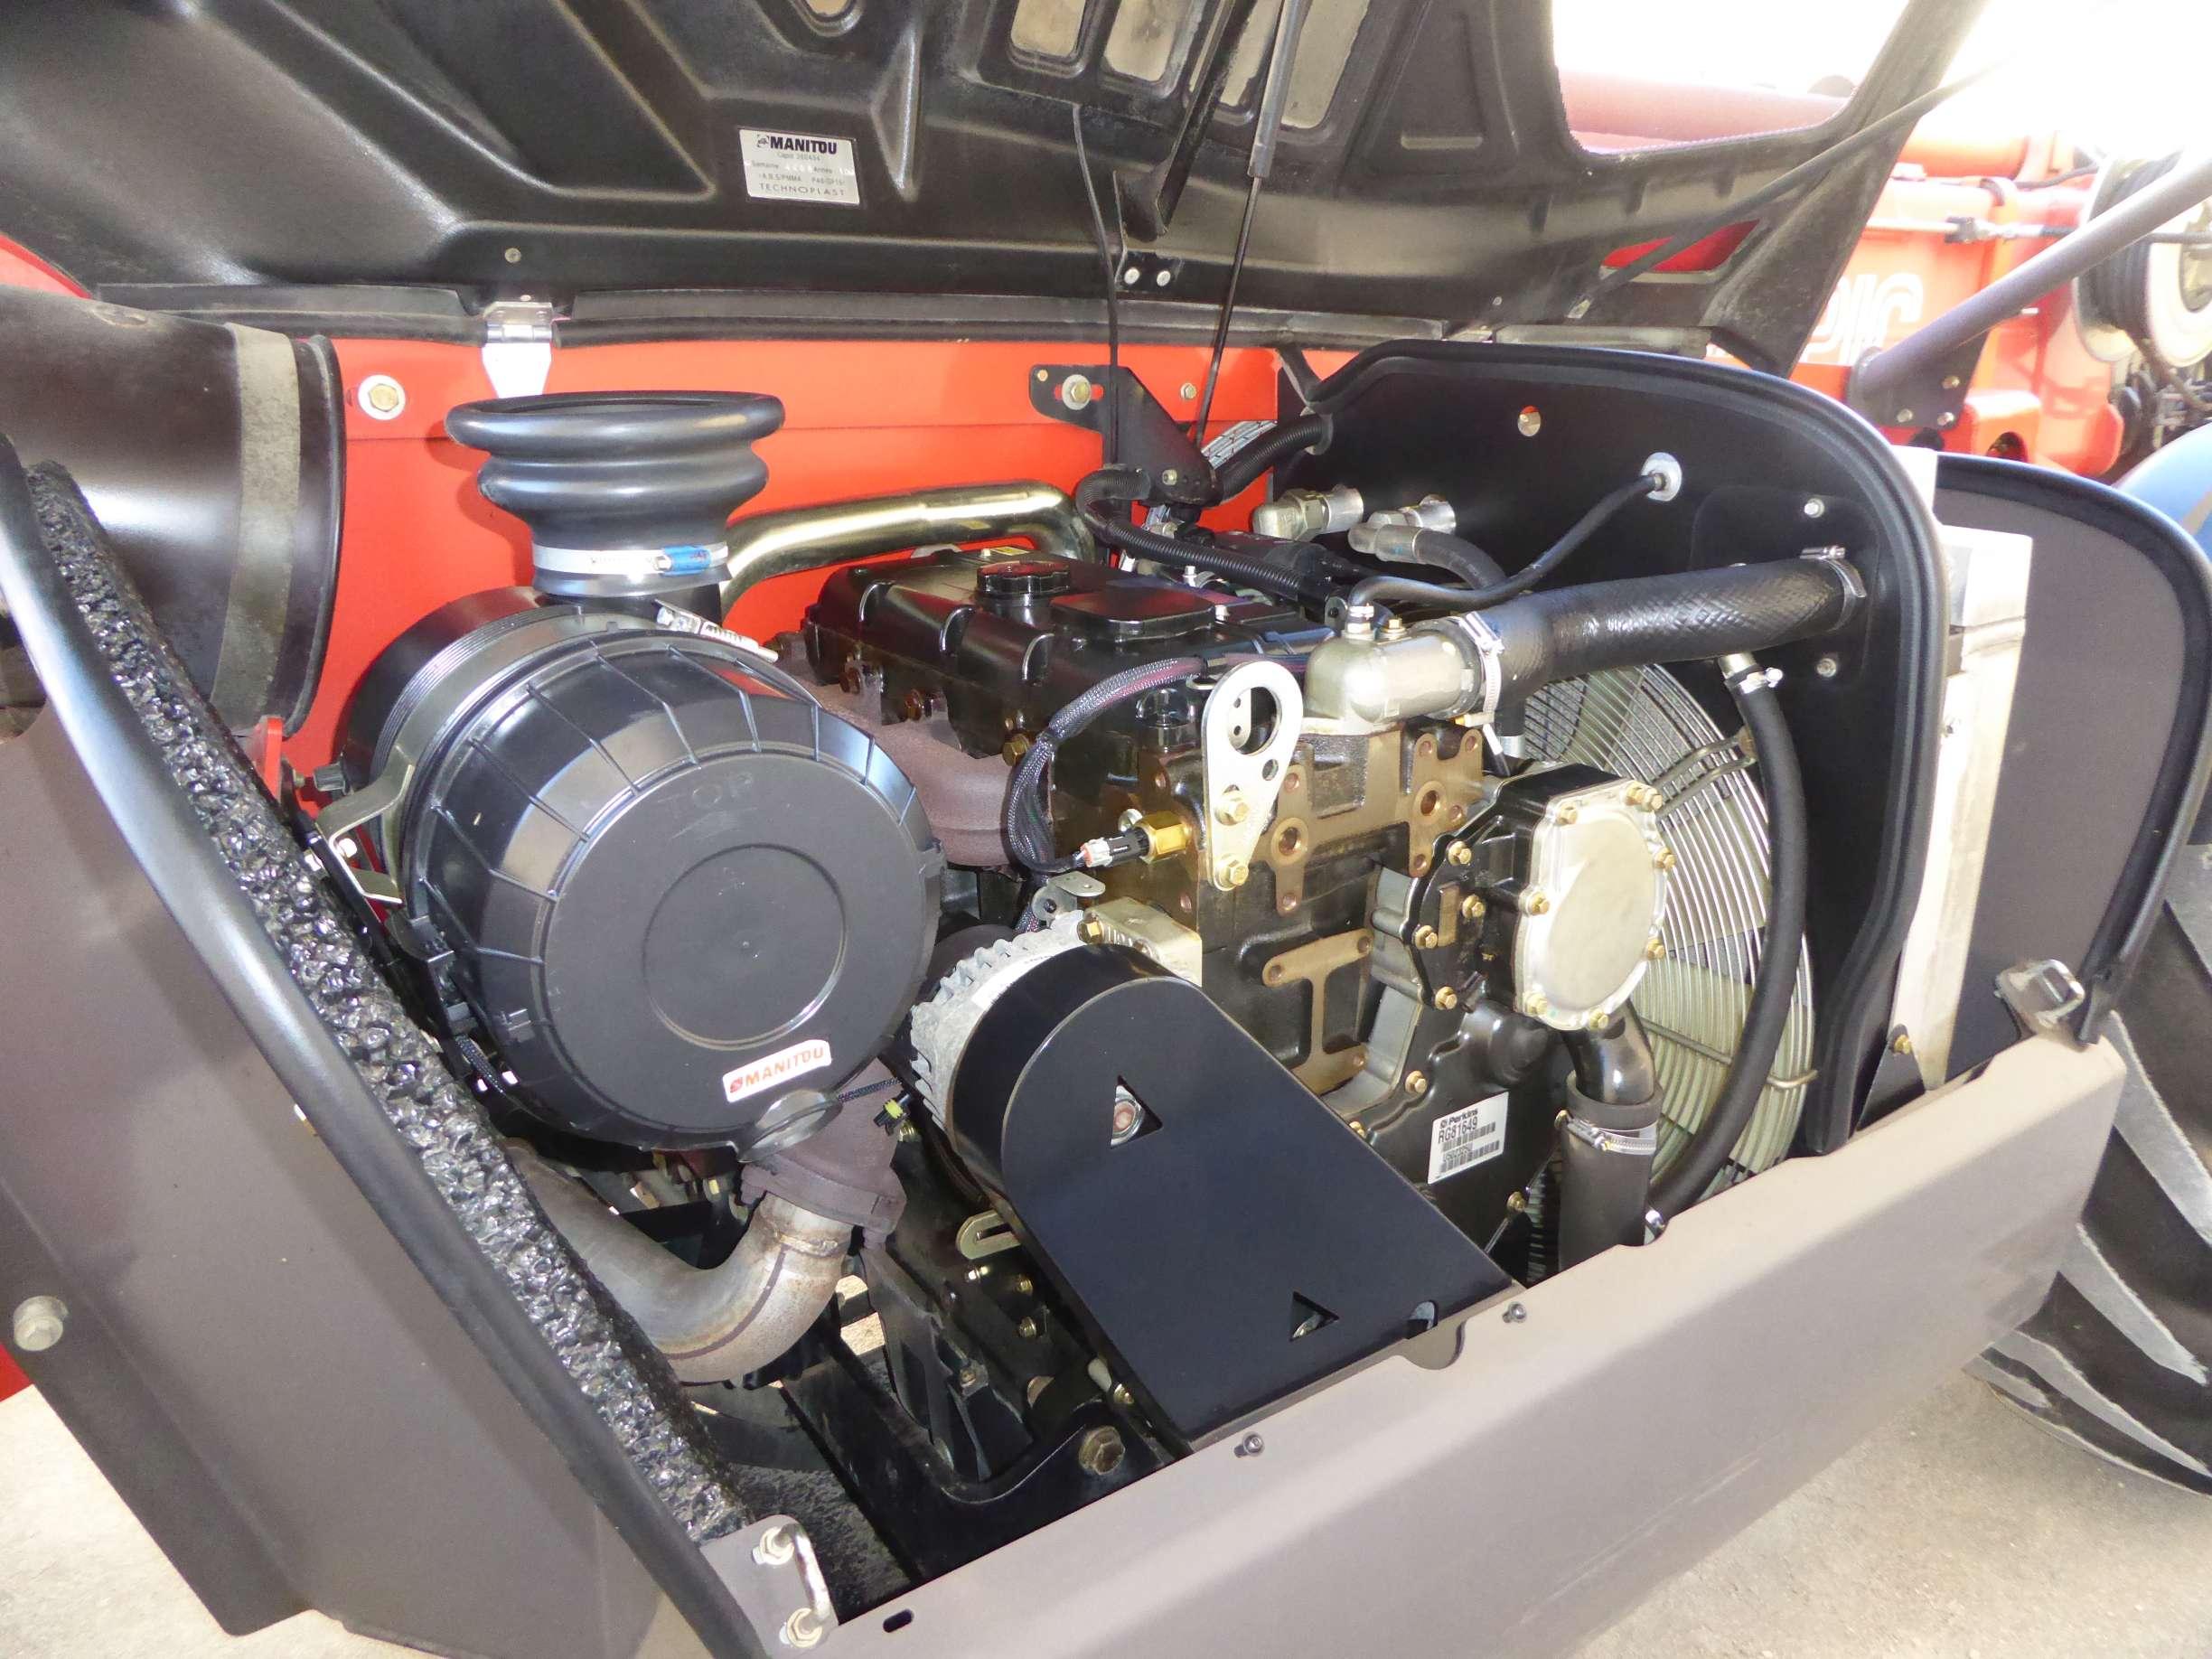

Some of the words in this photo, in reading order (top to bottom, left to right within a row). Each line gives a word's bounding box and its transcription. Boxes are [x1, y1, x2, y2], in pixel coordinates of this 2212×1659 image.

[769, 136, 838, 155] MANITOU
[759, 183, 846, 196] TECHNOPLAST
[745, 1046, 824, 1087] MANITOU
[1448, 1108, 1478, 1126] Perkins
[1438, 1116, 1478, 1145] RG81649
